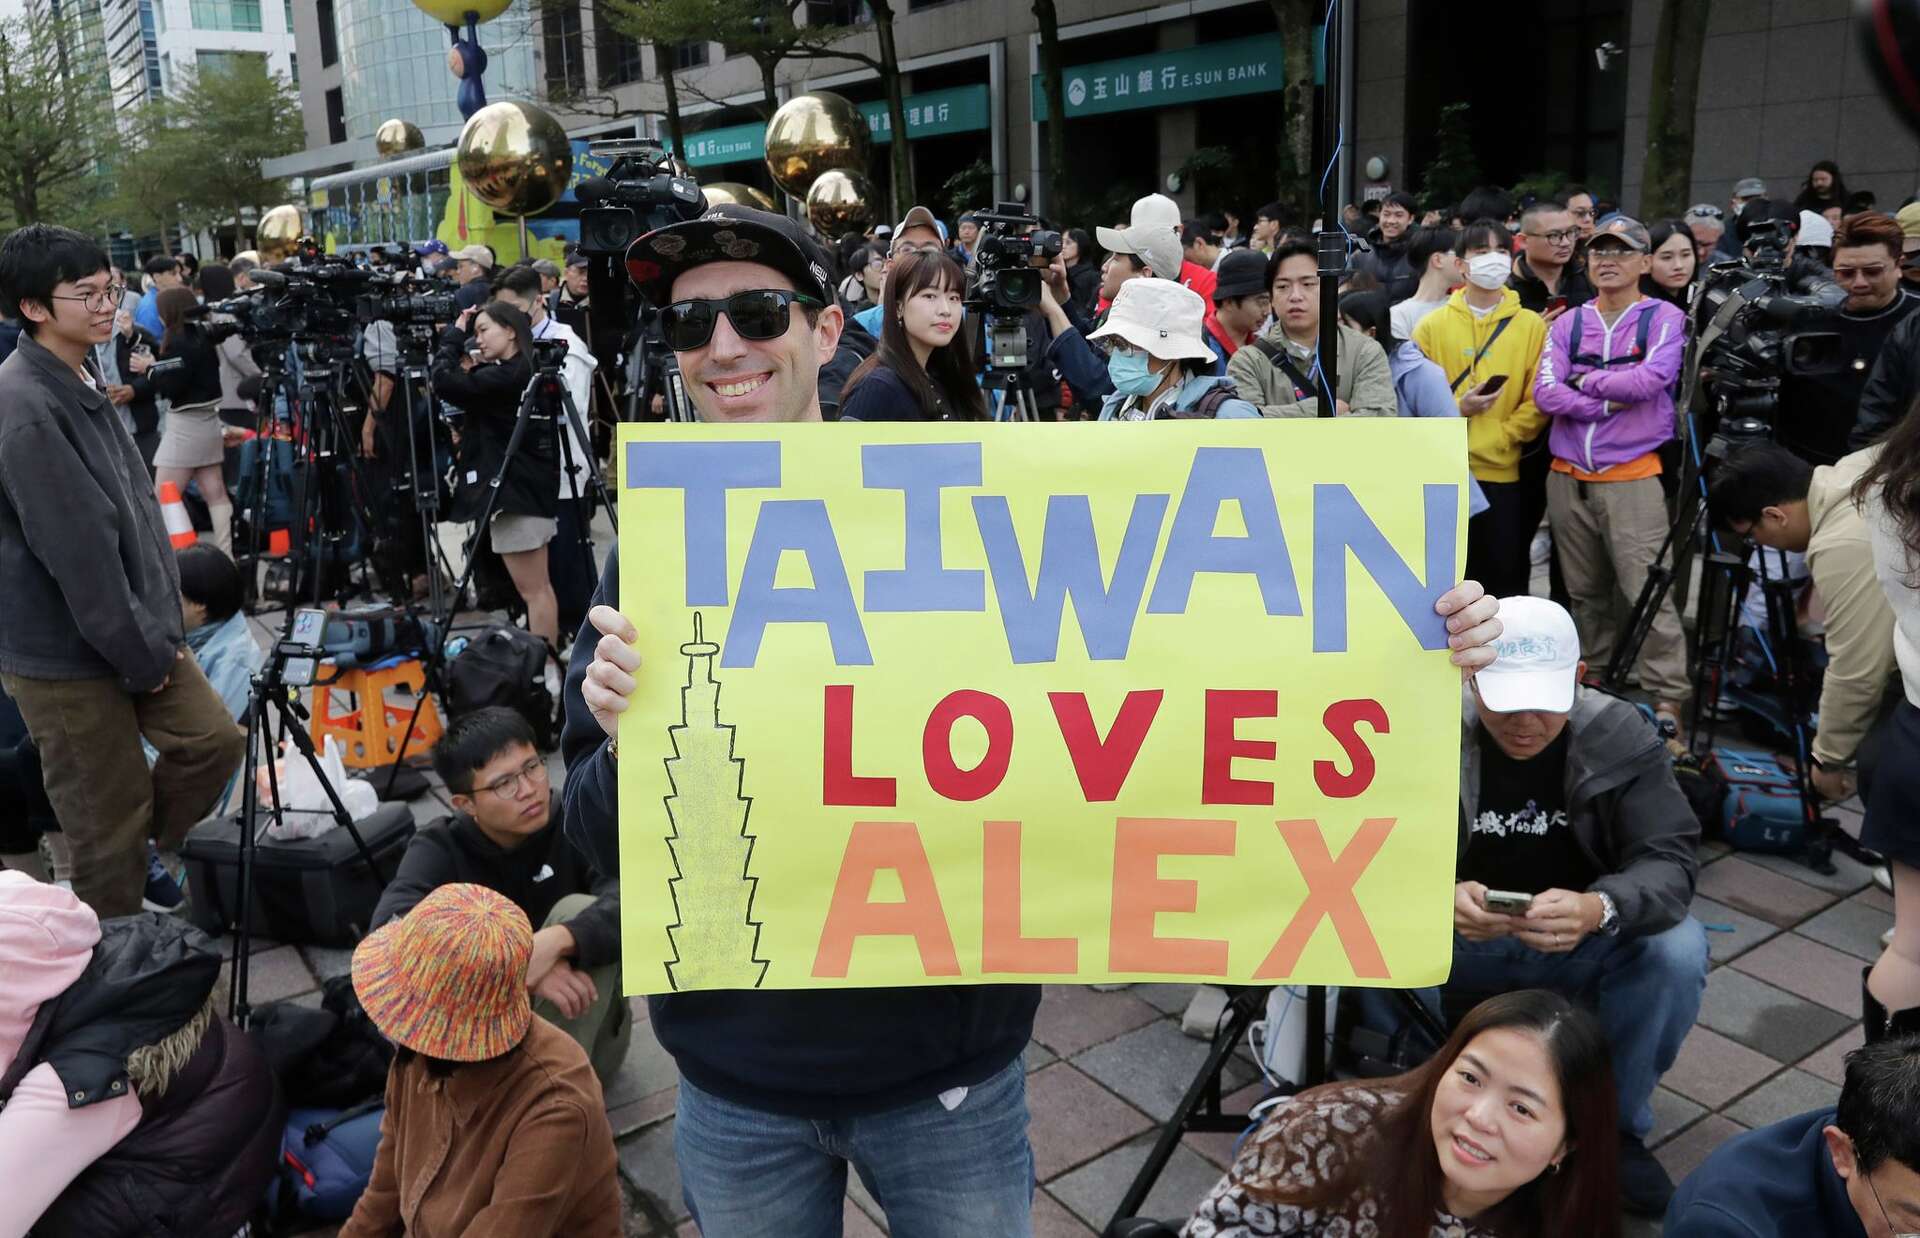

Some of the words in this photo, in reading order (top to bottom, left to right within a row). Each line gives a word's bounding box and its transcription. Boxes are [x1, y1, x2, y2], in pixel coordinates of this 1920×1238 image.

[1093, 66, 1176, 100] 玉山銀行
[1181, 70, 1222, 88] E.SUN
[1228, 63, 1268, 81] BANK
[626, 441, 1459, 668] TAIWAN
[823, 685, 1390, 806] LOVES
[811, 817, 1397, 979] ALEX
